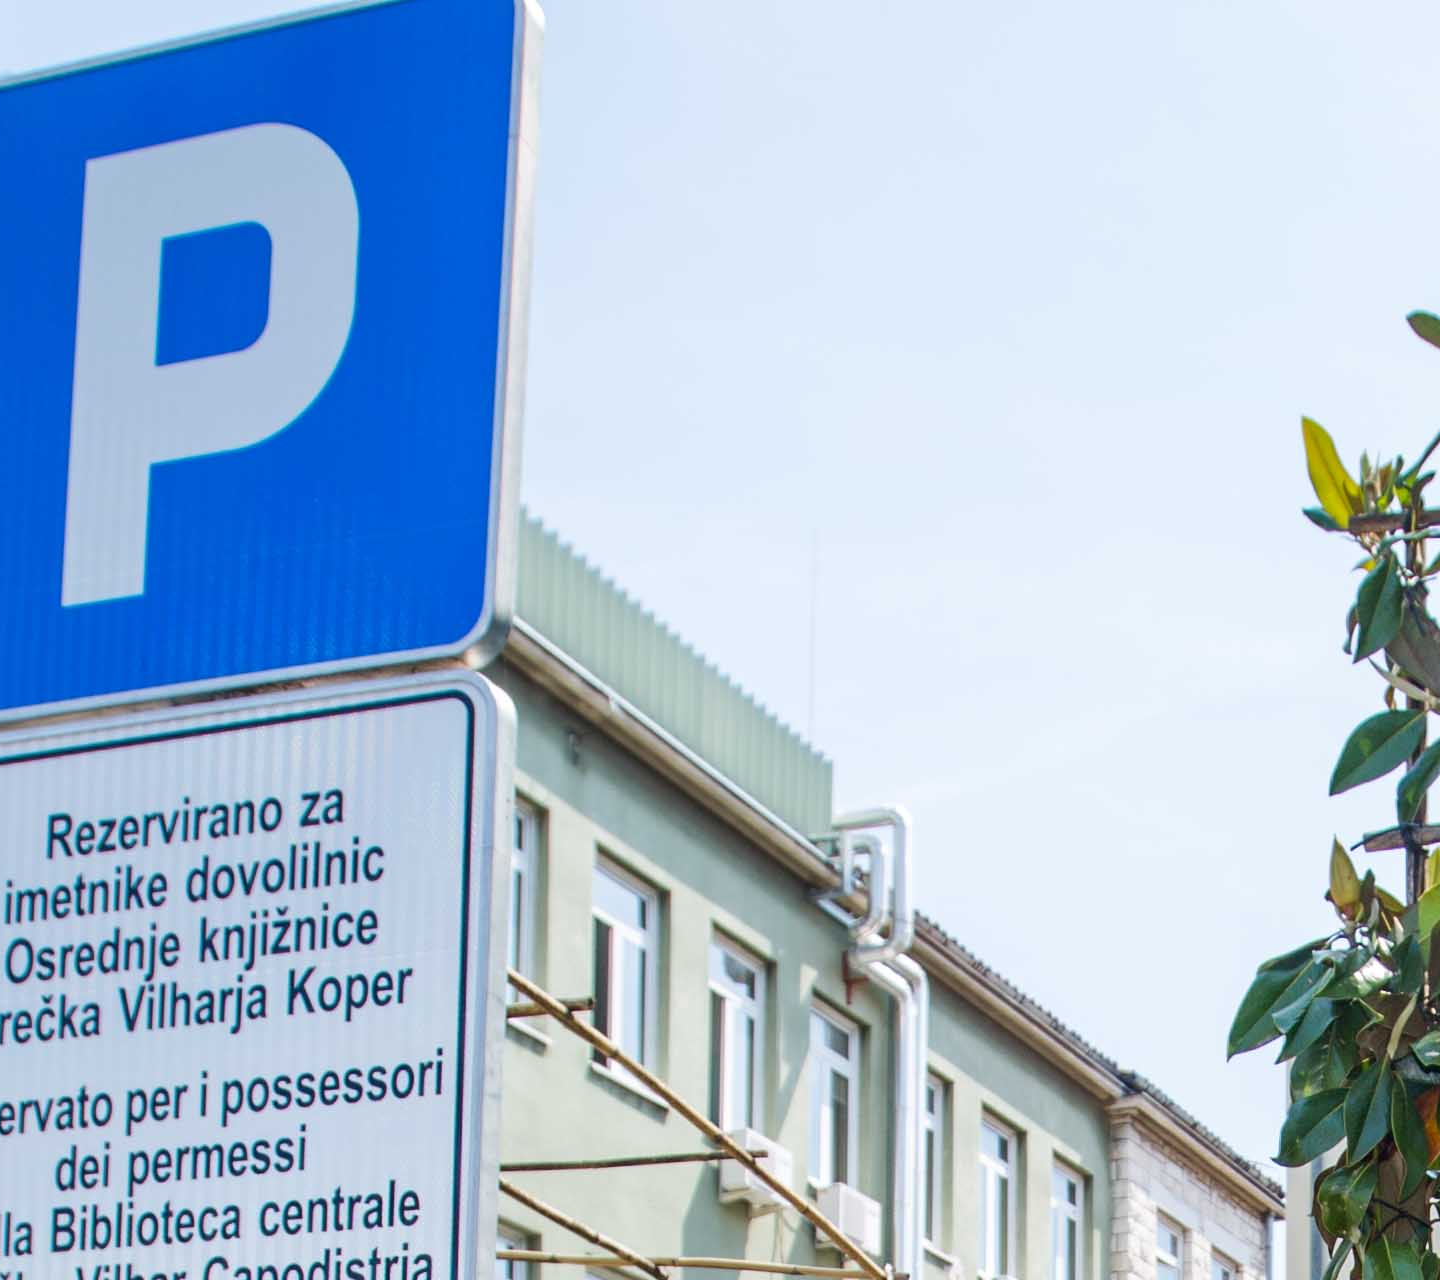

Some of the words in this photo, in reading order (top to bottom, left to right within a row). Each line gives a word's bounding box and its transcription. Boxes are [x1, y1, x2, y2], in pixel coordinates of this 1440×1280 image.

[60, 121, 360, 608] P
[47, 796, 283, 860] Rezervirano
[299, 788, 344, 828] za
[5, 865, 168, 925] imetnike
[186, 836, 385, 903] dovolilnic
[5, 922, 181, 985] Osrednje
[199, 902, 378, 972] knjižnice
[119, 974, 267, 1035] Vilharja
[287, 966, 413, 1023] Koper
[125, 1085, 189, 1137] per
[199, 1068, 210, 1119] i
[221, 1047, 444, 1128] possessori
[55, 1141, 111, 1192] dei
[127, 1123, 307, 1198] permessi
[51, 1201, 241, 1253] Biblioteca
[259, 1179, 420, 1237] centrale
